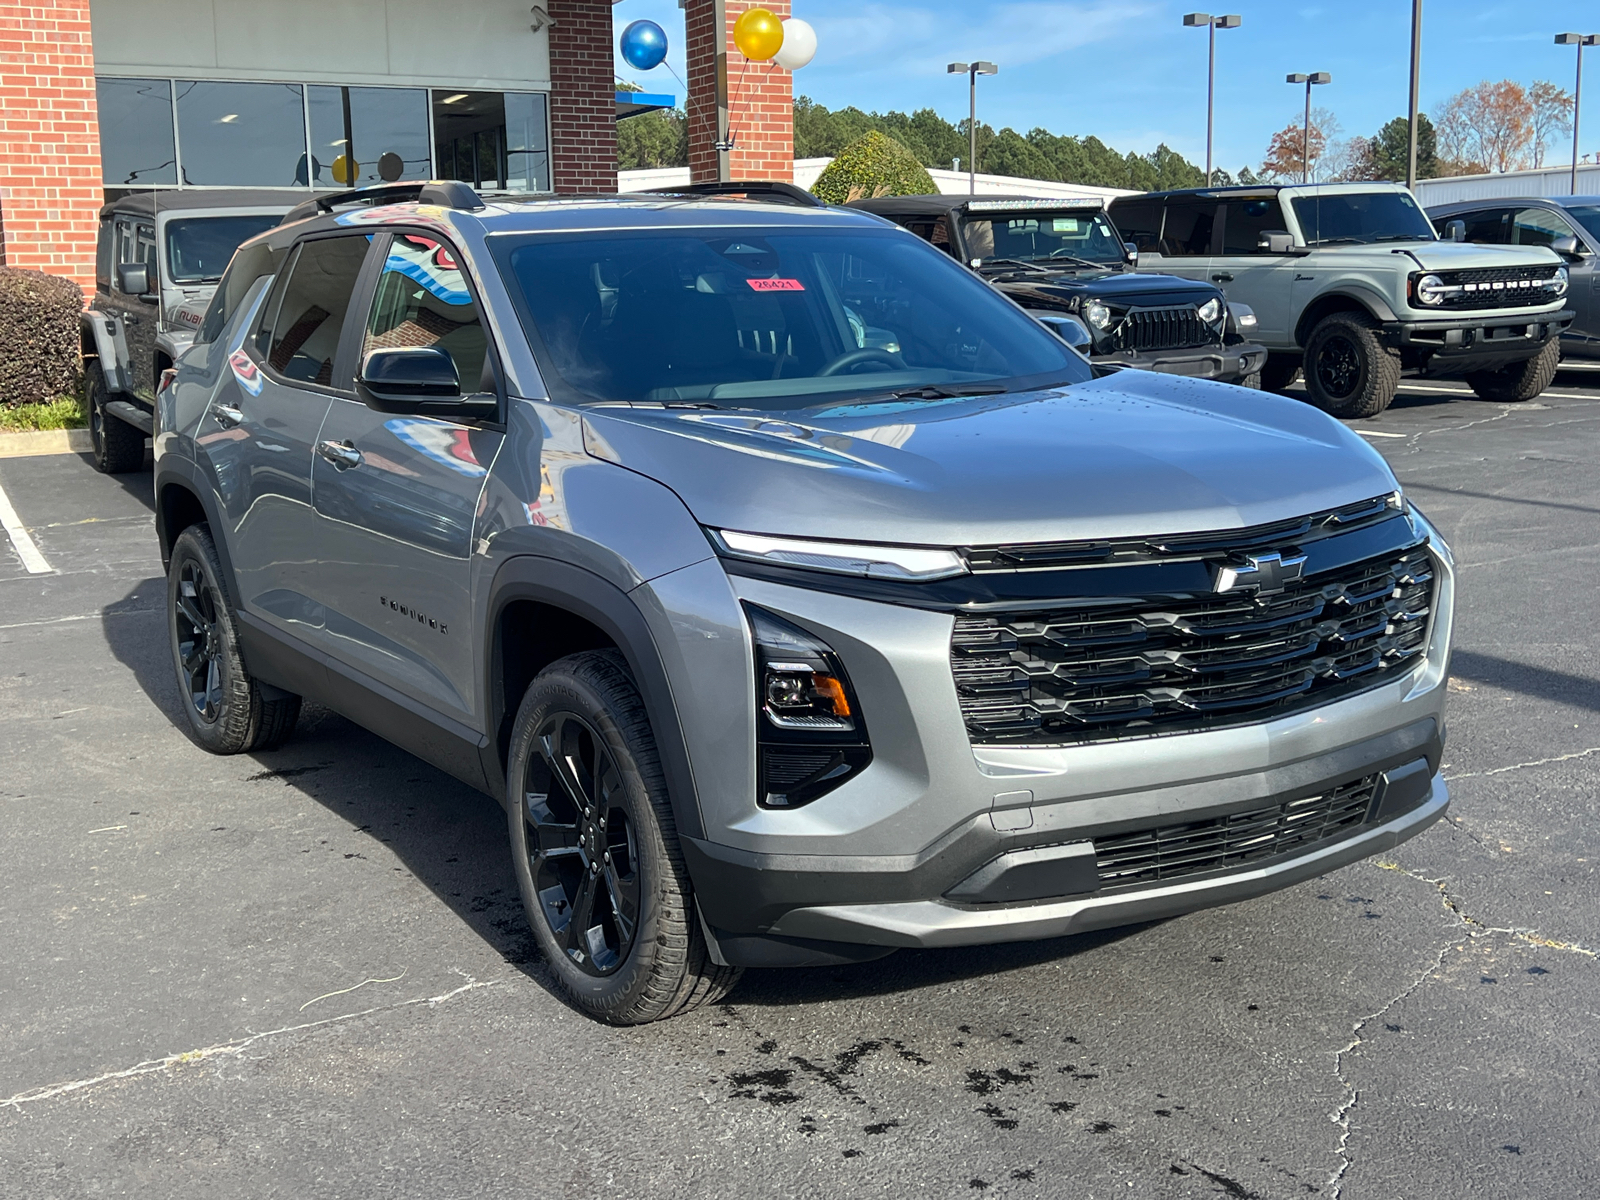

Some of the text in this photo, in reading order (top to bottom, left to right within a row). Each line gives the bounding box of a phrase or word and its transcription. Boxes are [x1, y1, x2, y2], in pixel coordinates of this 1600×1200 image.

[1464, 279, 1543, 291] BRONCO
[179, 310, 203, 325] RUBI
[380, 596, 448, 635] EQUINOX
